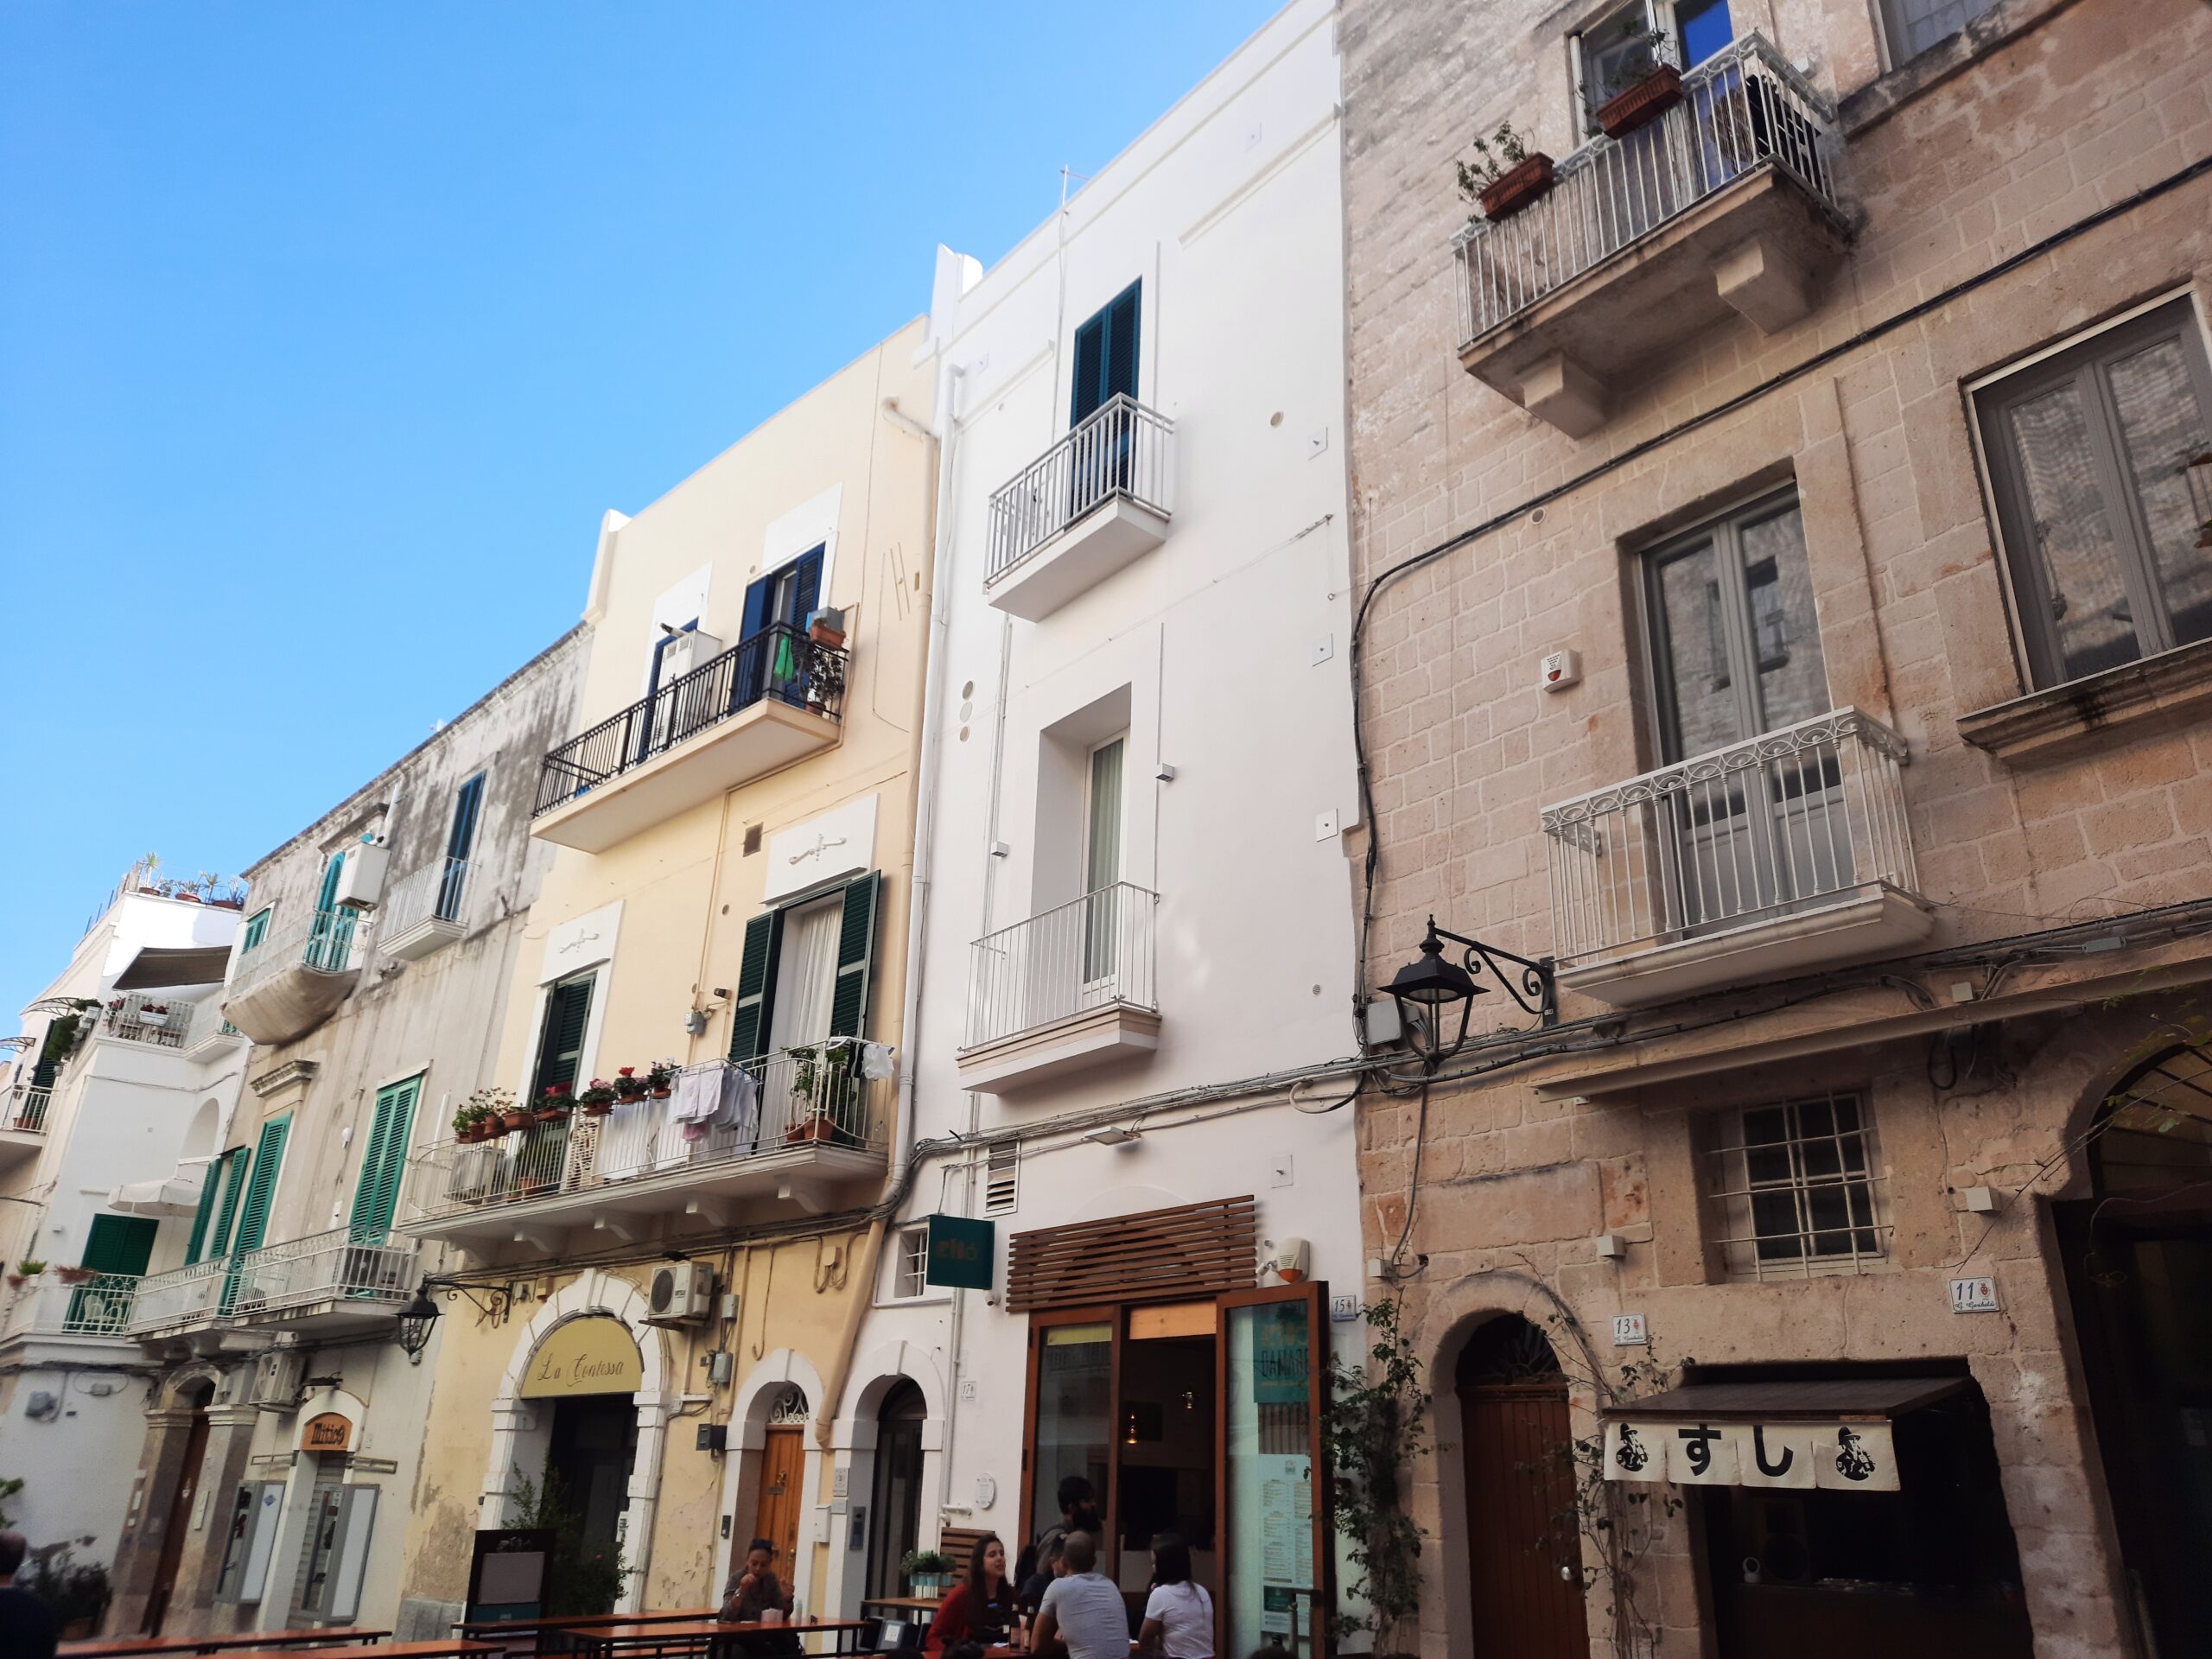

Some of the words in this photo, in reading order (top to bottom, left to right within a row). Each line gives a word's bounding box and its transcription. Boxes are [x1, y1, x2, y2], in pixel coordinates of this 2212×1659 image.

[1956, 1282, 1974, 1300] 11
[1335, 1299, 1345, 1313] 15
[1617, 1318, 1630, 1334] 13
[537, 1352, 562, 1382] La
[566, 1353, 625, 1388] Contessa
[1678, 1423, 1794, 1477] すし
